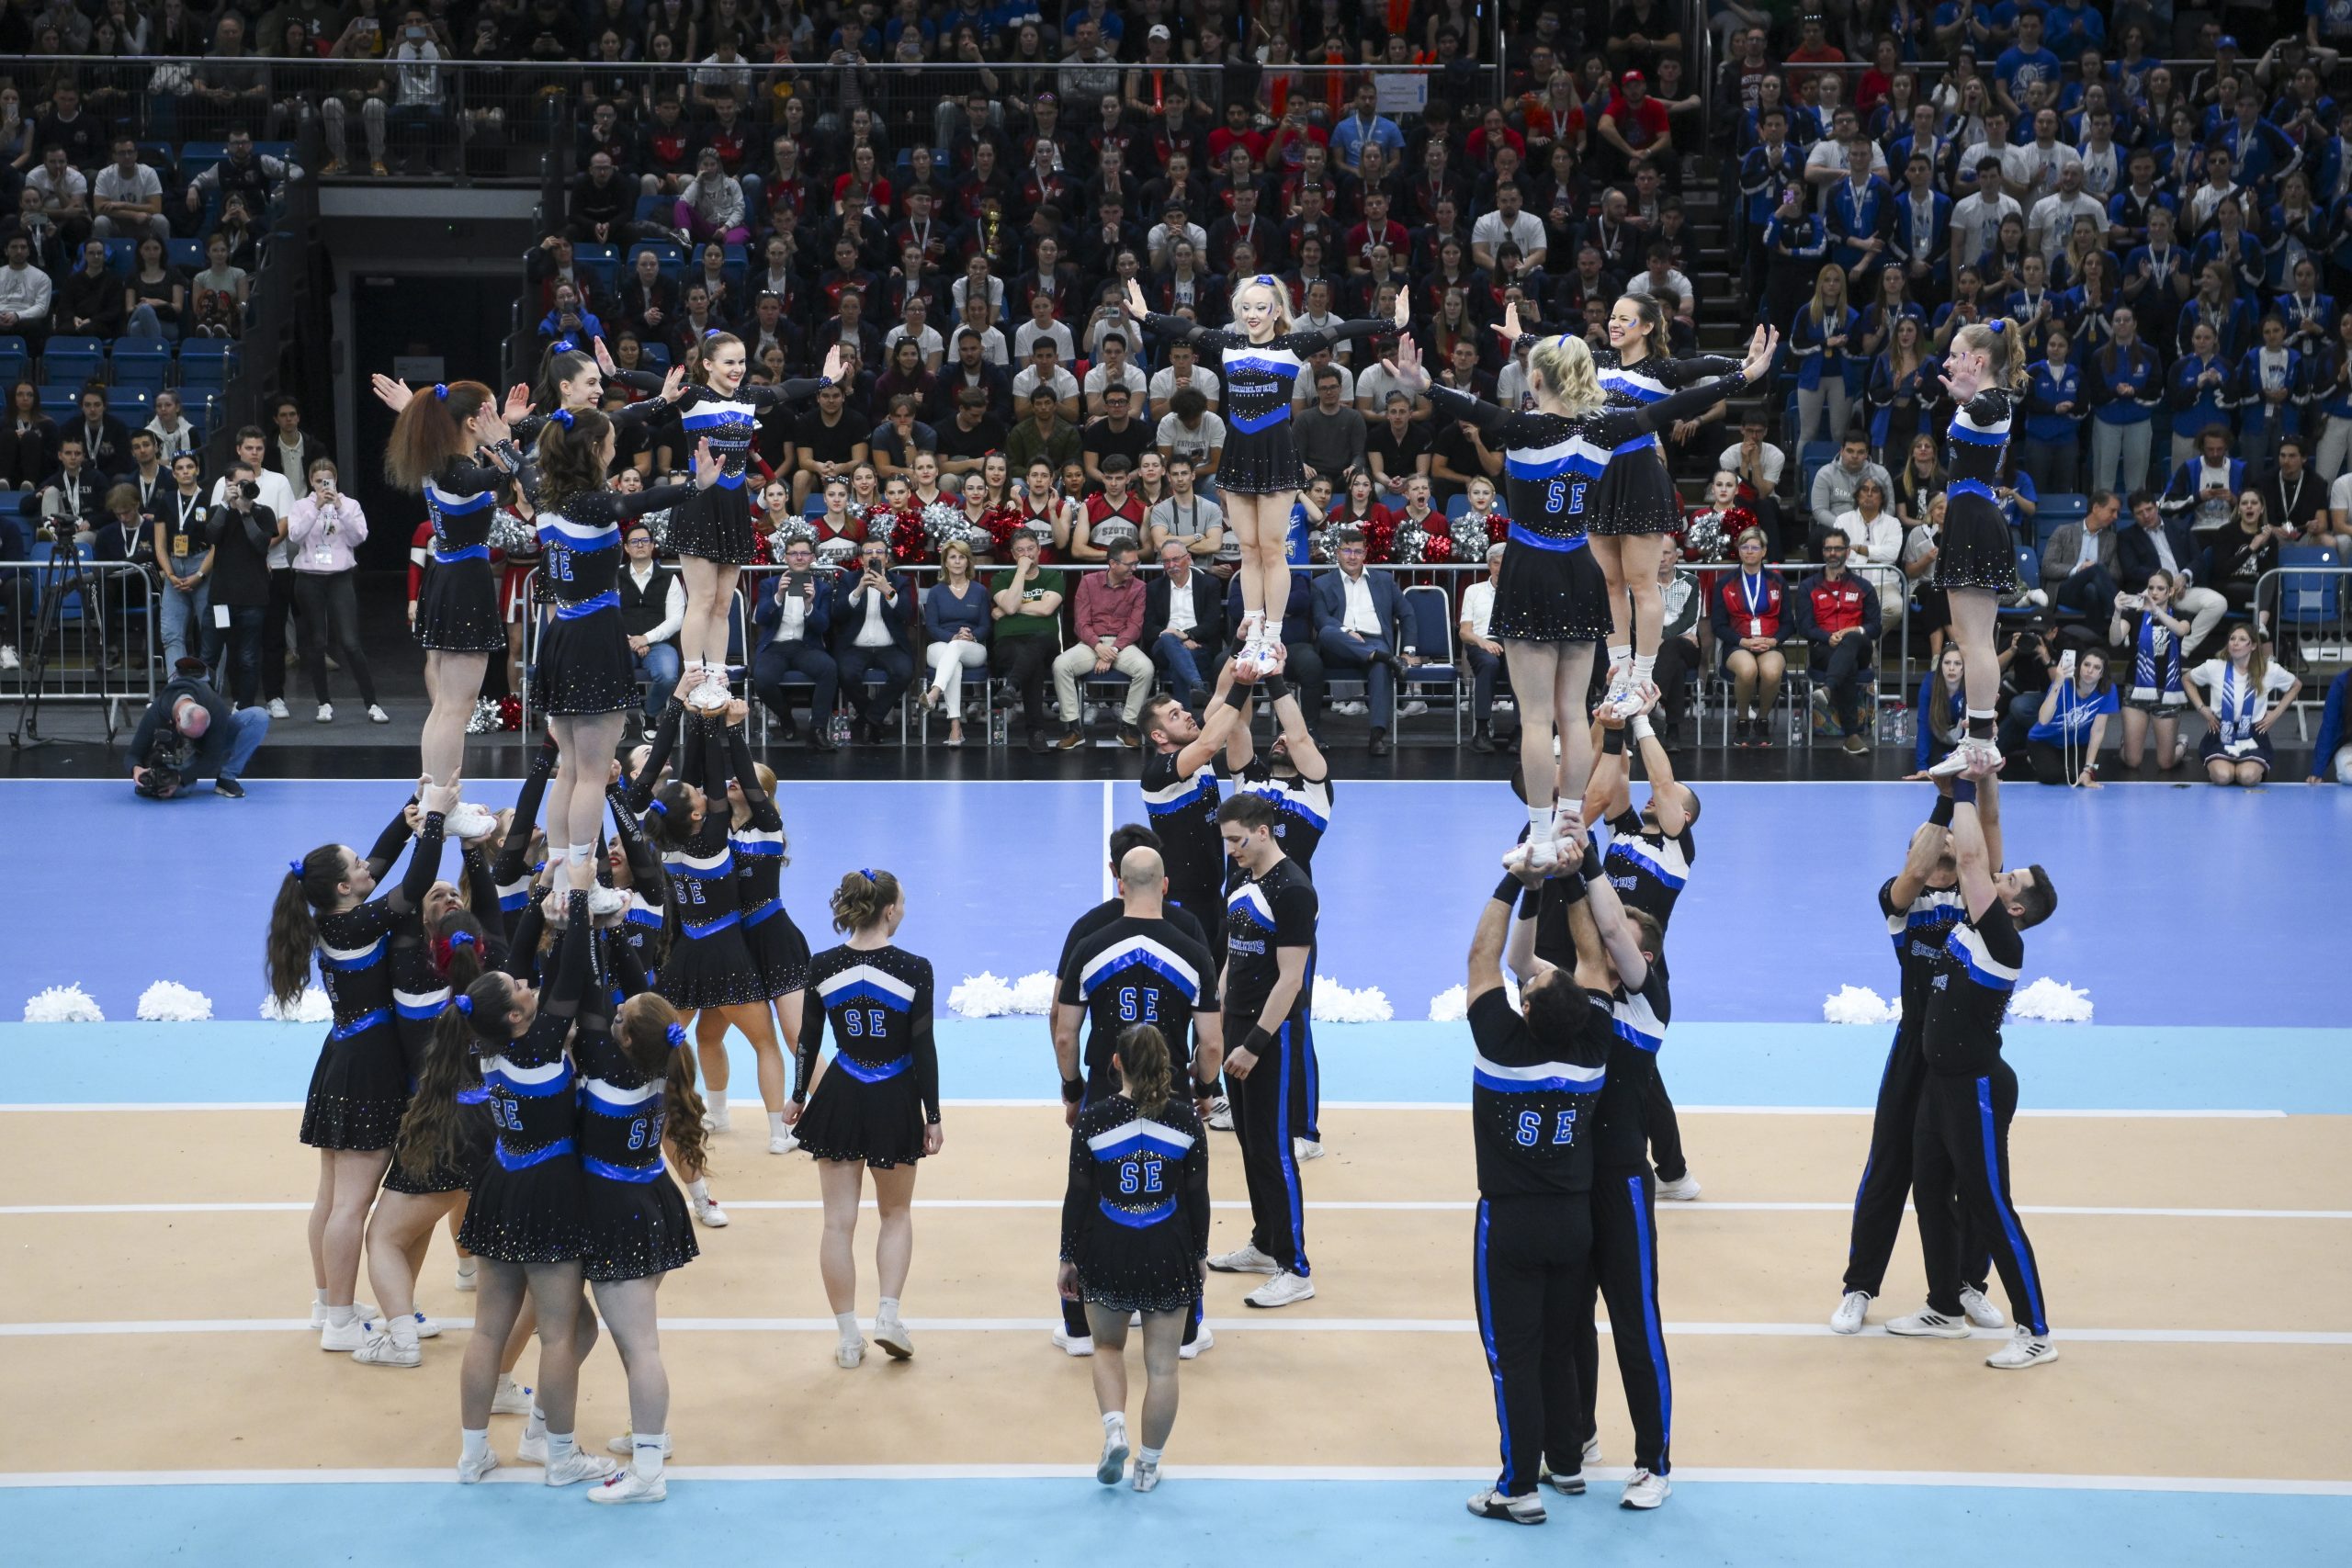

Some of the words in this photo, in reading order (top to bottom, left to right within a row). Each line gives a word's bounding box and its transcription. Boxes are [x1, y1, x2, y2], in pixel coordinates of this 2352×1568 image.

[1119, 987, 1159, 1022] SE
[845, 1010, 887, 1037] SE
[1120, 1160, 1162, 1194] SE
